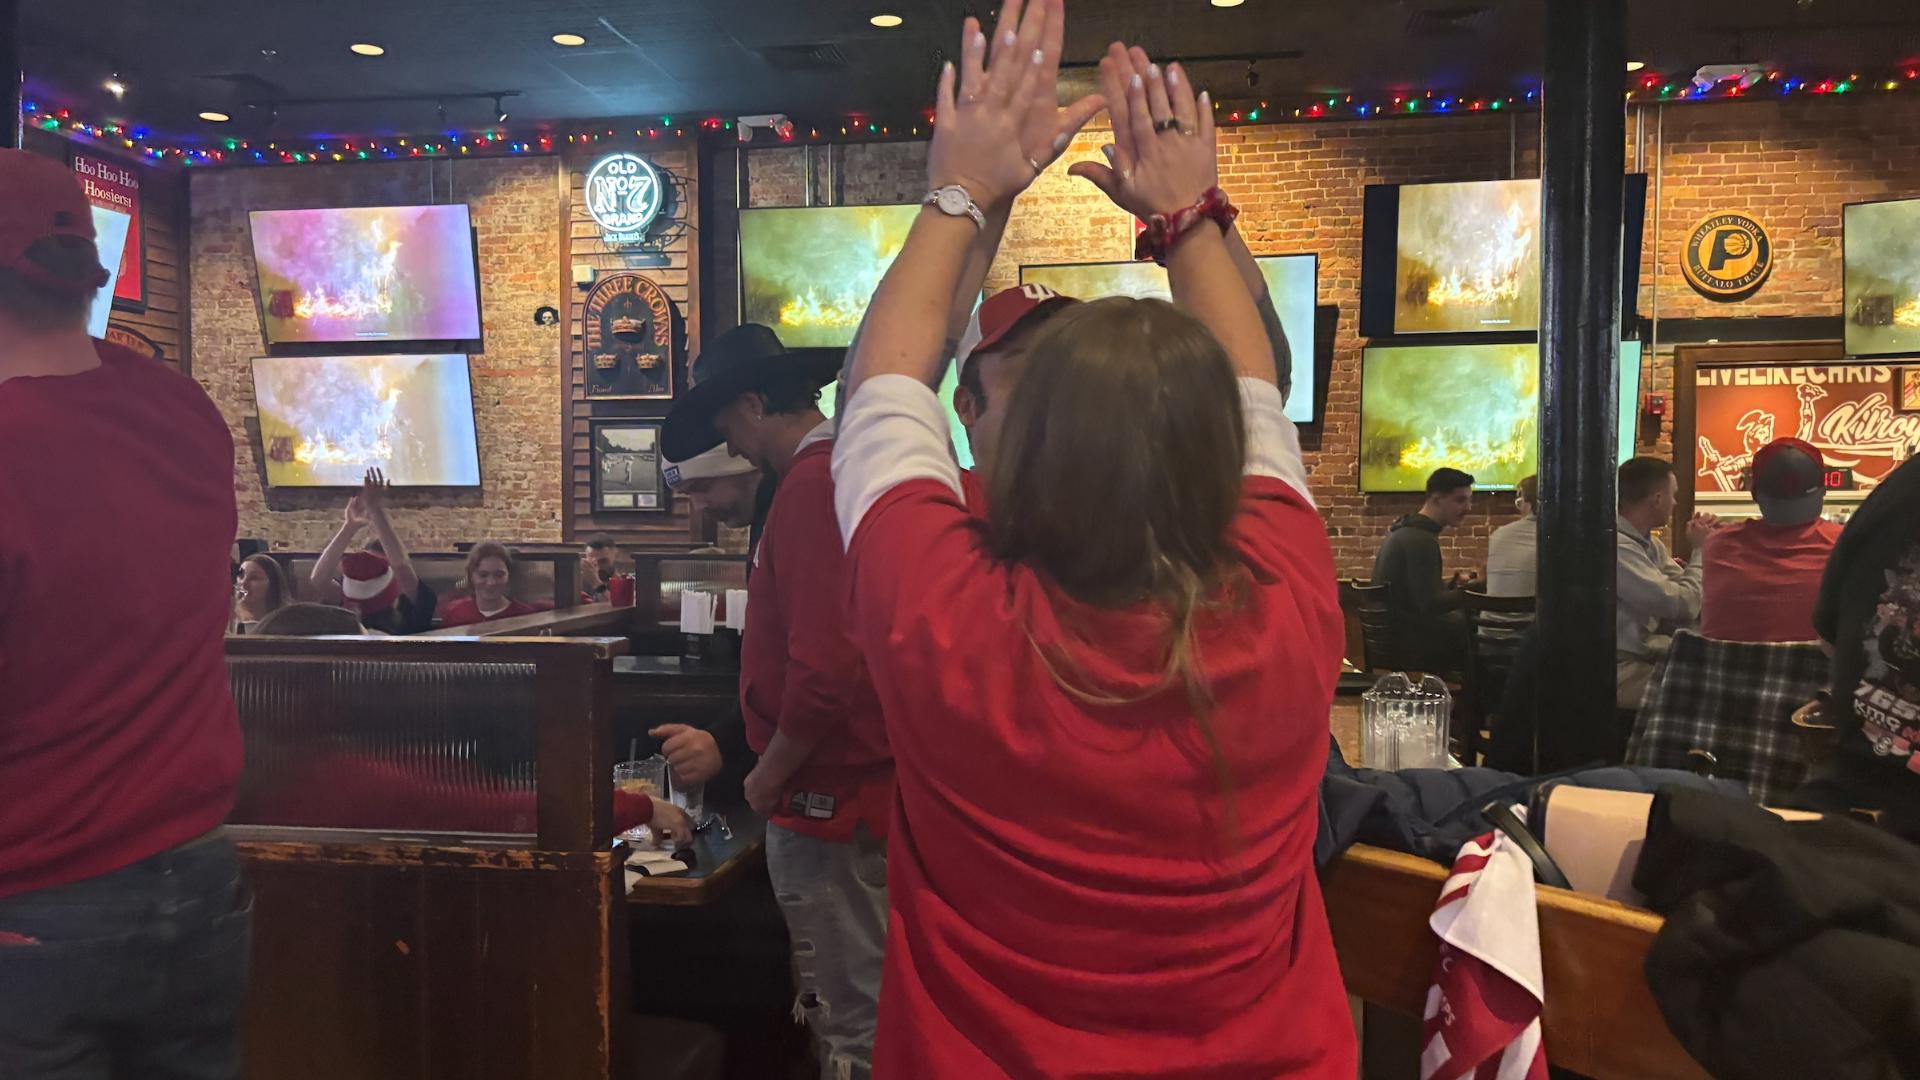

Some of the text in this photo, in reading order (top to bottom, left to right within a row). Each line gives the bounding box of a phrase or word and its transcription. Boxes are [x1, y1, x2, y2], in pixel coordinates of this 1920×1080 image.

[75, 156, 139, 189] Hoo Hoo Hoo
[608, 161, 637, 175] OLD
[84, 179, 132, 208] Hoosiers!
[1691, 216, 1764, 247] WHEATLEY VODKA
[1693, 262, 1765, 289] BUFFALO TRACE
[587, 276, 669, 351] THE THREE CROWNS
